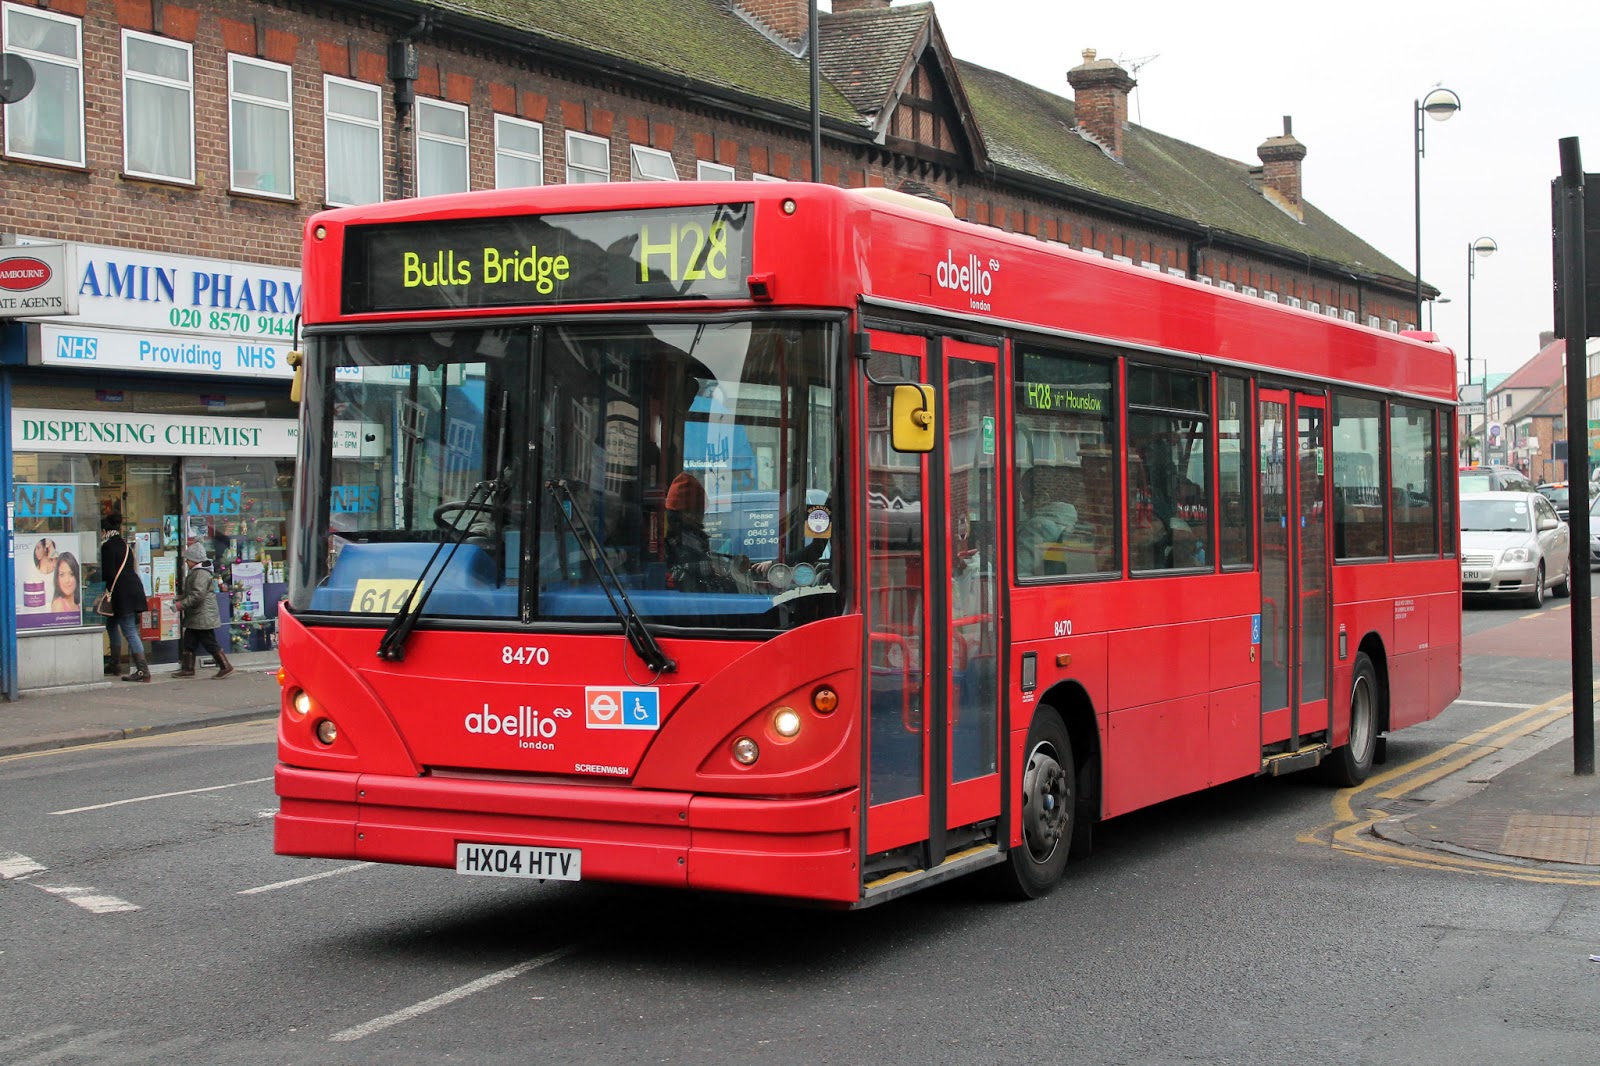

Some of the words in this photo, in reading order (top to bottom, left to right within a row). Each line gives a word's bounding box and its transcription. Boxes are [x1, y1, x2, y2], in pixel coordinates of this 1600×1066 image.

[640, 219, 729, 282] H28
[0, 269, 45, 279] AMBOURNE
[403, 251, 472, 288] Bulls
[483, 245, 570, 294] Bridge
[936, 248, 992, 296] abellio
[79, 259, 177, 304] AMIN
[191, 271, 302, 315] PHARM
[20, 296, 62, 308] AGENTS
[969, 297, 991, 312] london
[169, 307, 202, 329] 020
[209, 311, 251, 333] 8570
[257, 316, 294, 337] 9144
[57, 335, 98, 360] NHS
[139, 340, 222, 371] Providing
[237, 346, 276, 369] NHS
[1027, 382, 1052, 410] H28
[1065, 390, 1102, 411] Hounslow
[22, 419, 156, 444] DISPENSING
[164, 425, 263, 447] CHEMIST
[17, 487, 73, 515] NHS
[187, 488, 239, 514] NHS
[333, 488, 378, 512] NHS
[747, 529, 768, 537] 0845
[769, 528, 775, 536] 9
[754, 520, 769, 528] Call
[743, 538, 755, 546] 60
[756, 537, 767, 545] 50
[1463, 571, 1479, 579] ERU
[1053, 620, 1072, 636] 8470
[501, 646, 550, 666] 8470
[464, 703, 557, 738] abellio
[518, 739, 555, 751] london
[574, 763, 629, 776] SCREENWASH
[465, 847, 522, 874] HX04
[529, 850, 573, 877] HTV
